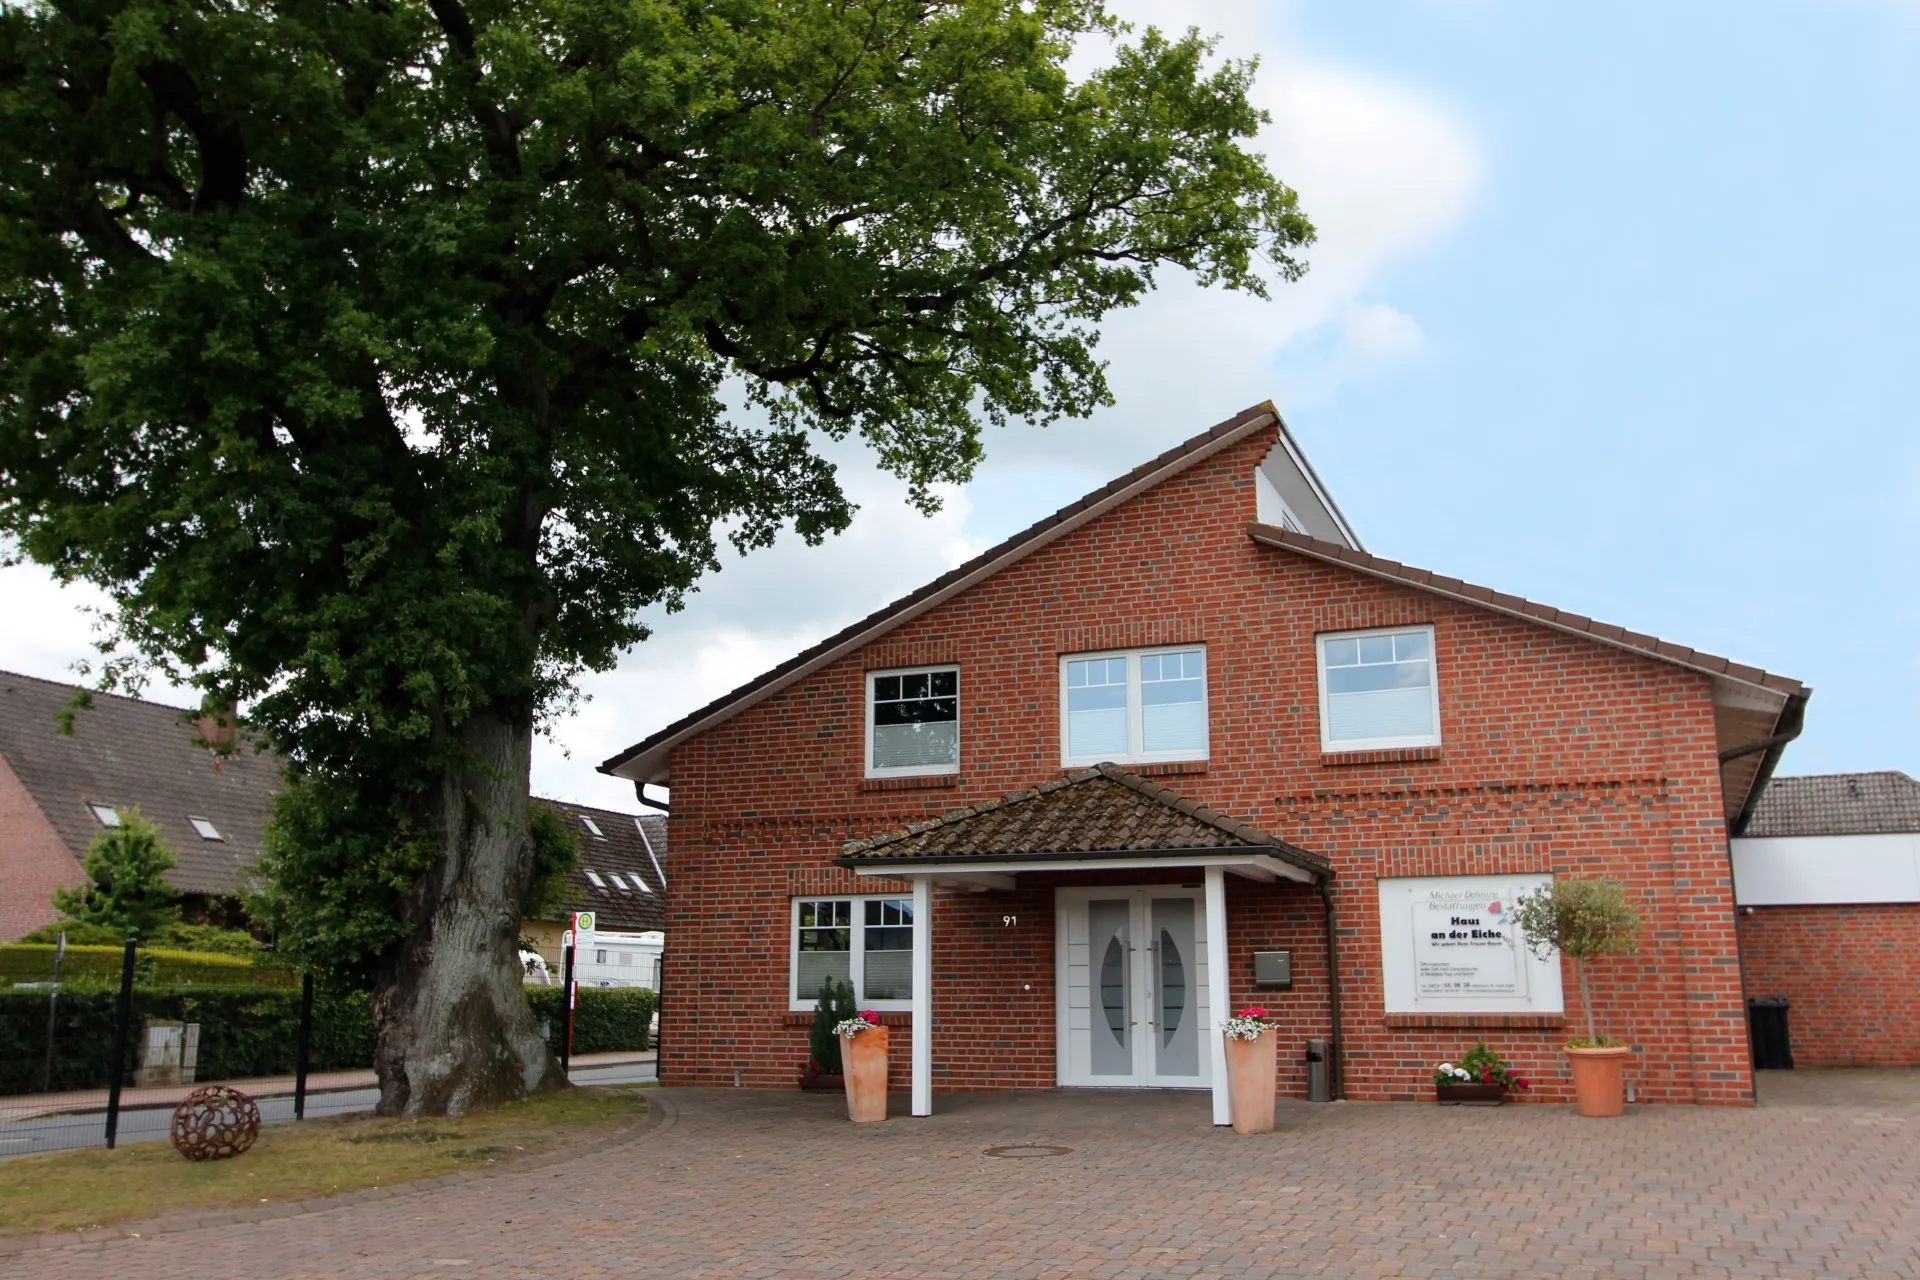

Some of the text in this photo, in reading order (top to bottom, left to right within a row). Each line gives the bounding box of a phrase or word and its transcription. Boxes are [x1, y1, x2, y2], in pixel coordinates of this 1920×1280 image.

[1429, 890, 1461, 899] Michael
[1429, 902, 1486, 911] Bestattungen
[582, 916, 589, 926] H
[1003, 915, 1017, 927] 91
[1451, 917, 1480, 926] Haus
[1449, 930, 1468, 939] der
[1471, 929, 1502, 939] Eiche
